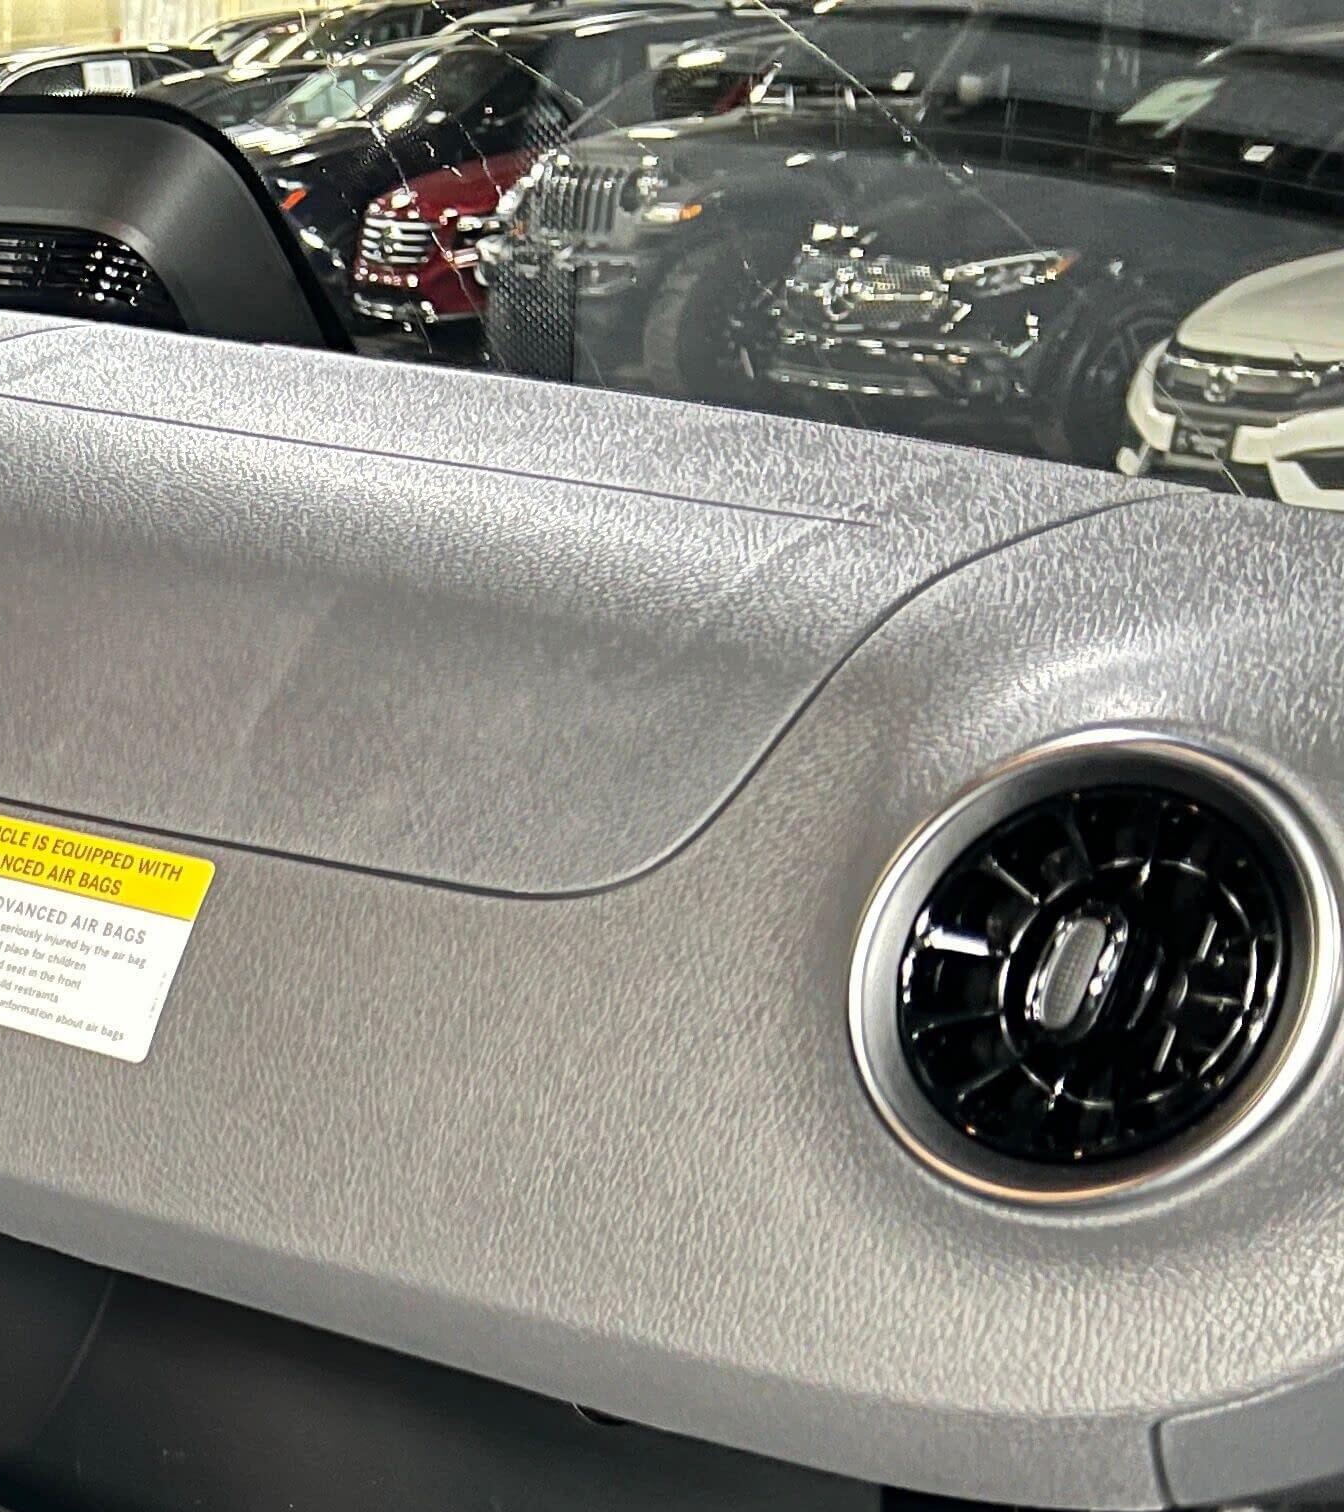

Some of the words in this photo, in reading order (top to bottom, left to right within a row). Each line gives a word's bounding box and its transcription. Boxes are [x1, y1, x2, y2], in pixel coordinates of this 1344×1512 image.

[32, 833, 49, 851] IS
[52, 839, 135, 870] EQUIPPED
[138, 857, 184, 882] WITH
[47, 865, 76, 885] AIR
[78, 871, 123, 895] BAGS
[71, 914, 99, 934] AIR
[102, 922, 146, 944] BAGS
[0, 923, 43, 943] seriously
[43, 932, 79, 949] injured
[80, 940, 92, 955] by
[94, 945, 110, 957] the
[112, 951, 126, 960] air
[127, 953, 147, 969] bag
[4, 942, 30, 957] place
[32, 947, 46, 960] for
[47, 953, 87, 971] children
[6, 963, 27, 977] seat
[28, 968, 38, 978] in
[40, 970, 56, 983] the
[57, 973, 82, 990] front
[14, 983, 59, 1004] restraints
[0, 999, 54, 1020] information
[55, 1014, 84, 1030] about
[85, 1022, 99, 1033] air
[100, 1023, 125, 1042] bags
